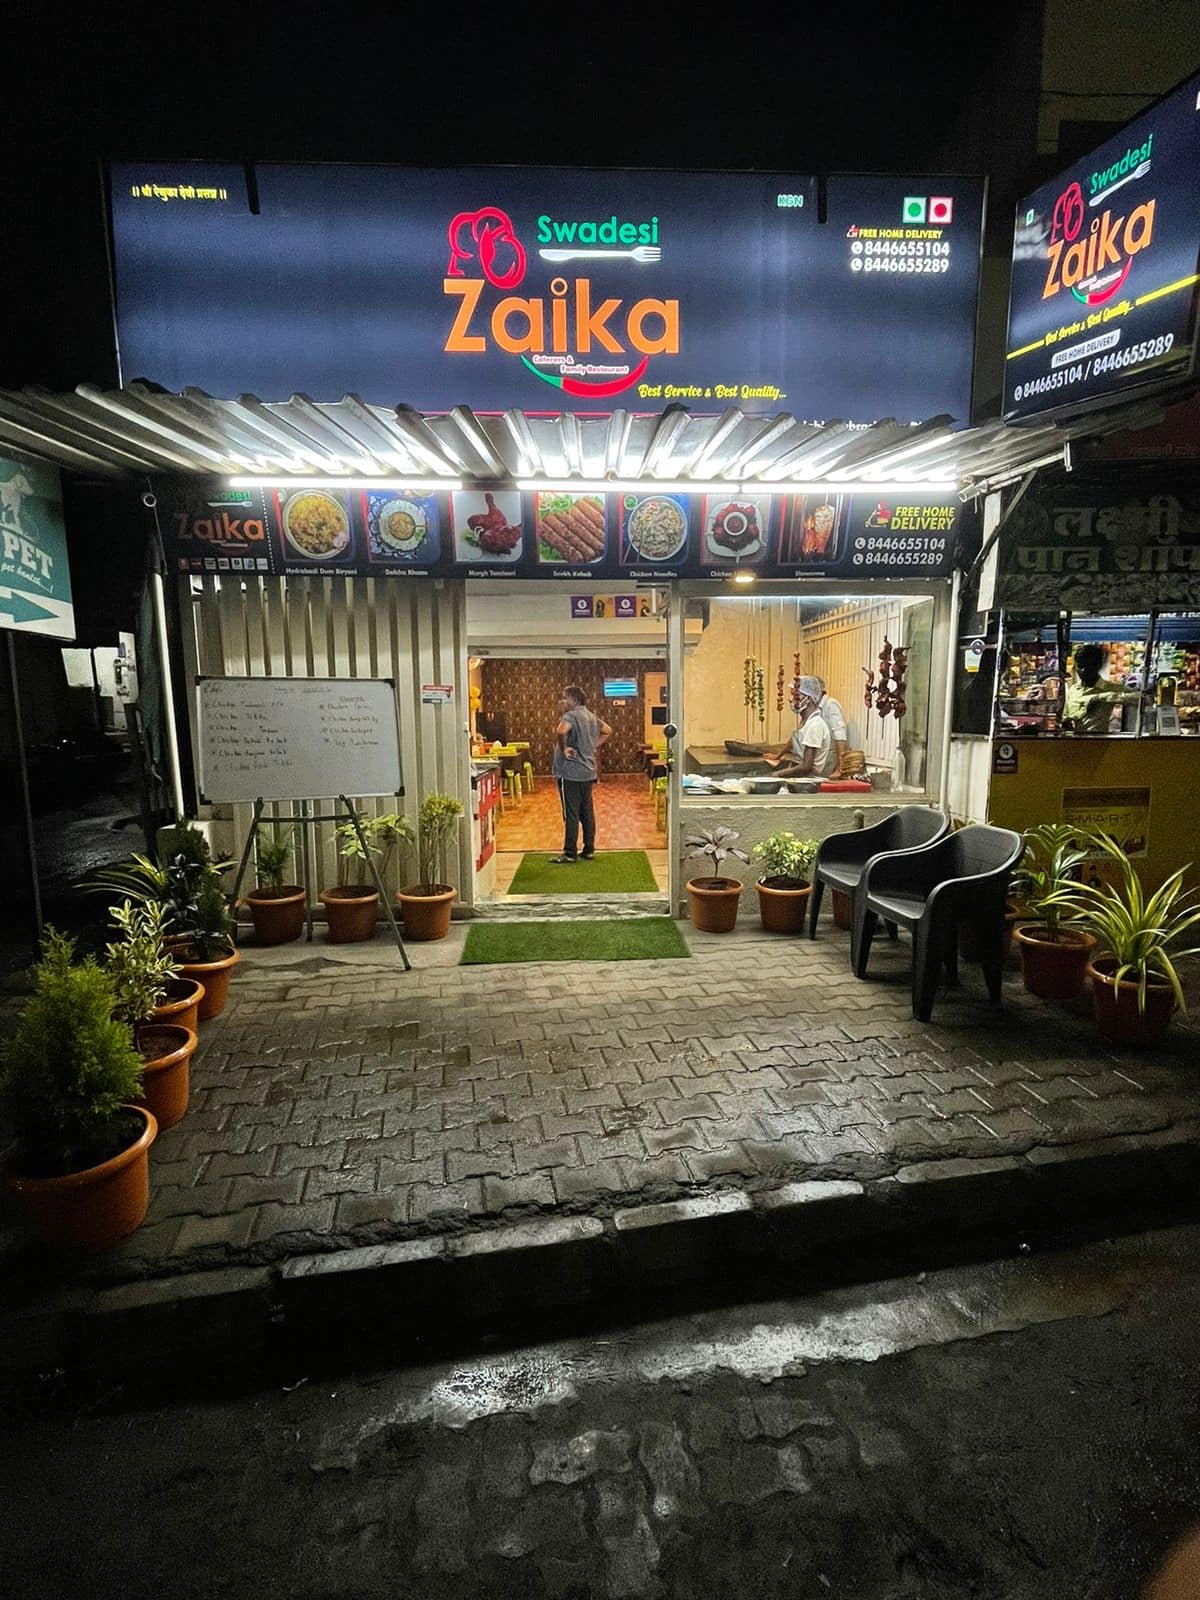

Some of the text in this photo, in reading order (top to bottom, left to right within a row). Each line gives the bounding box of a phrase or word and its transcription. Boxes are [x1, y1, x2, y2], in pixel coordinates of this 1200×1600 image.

[1090, 134, 1153, 194] Swadesi
[778, 194, 804, 207] KGN
[537, 215, 659, 244] Swadesi
[859, 229, 943, 238] FREE HOME DELIVERY
[864, 241, 950, 256] 8446655104
[1043, 199, 1156, 300] Zaika
[864, 258, 949, 272] 8446655289
[443, 277, 680, 354] Zaika
[1086, 336, 1115, 353] DELIVERY
[1023, 364, 1083, 398] 8446655104
[1093, 333, 1174, 376] 8446655289
[638, 384, 662, 398] Best
[664, 384, 702, 398] Service
[704, 388, 711, 398] &
[714, 384, 738, 398] Best
[895, 507, 955, 517] FREE HOME
[173, 511, 265, 540] Zaika
[891, 518, 955, 530] DELIVERY
[867, 537, 945, 550] 8446655104
[3, 531, 53, 579] PET
[865, 552, 943, 565] 8446655289
